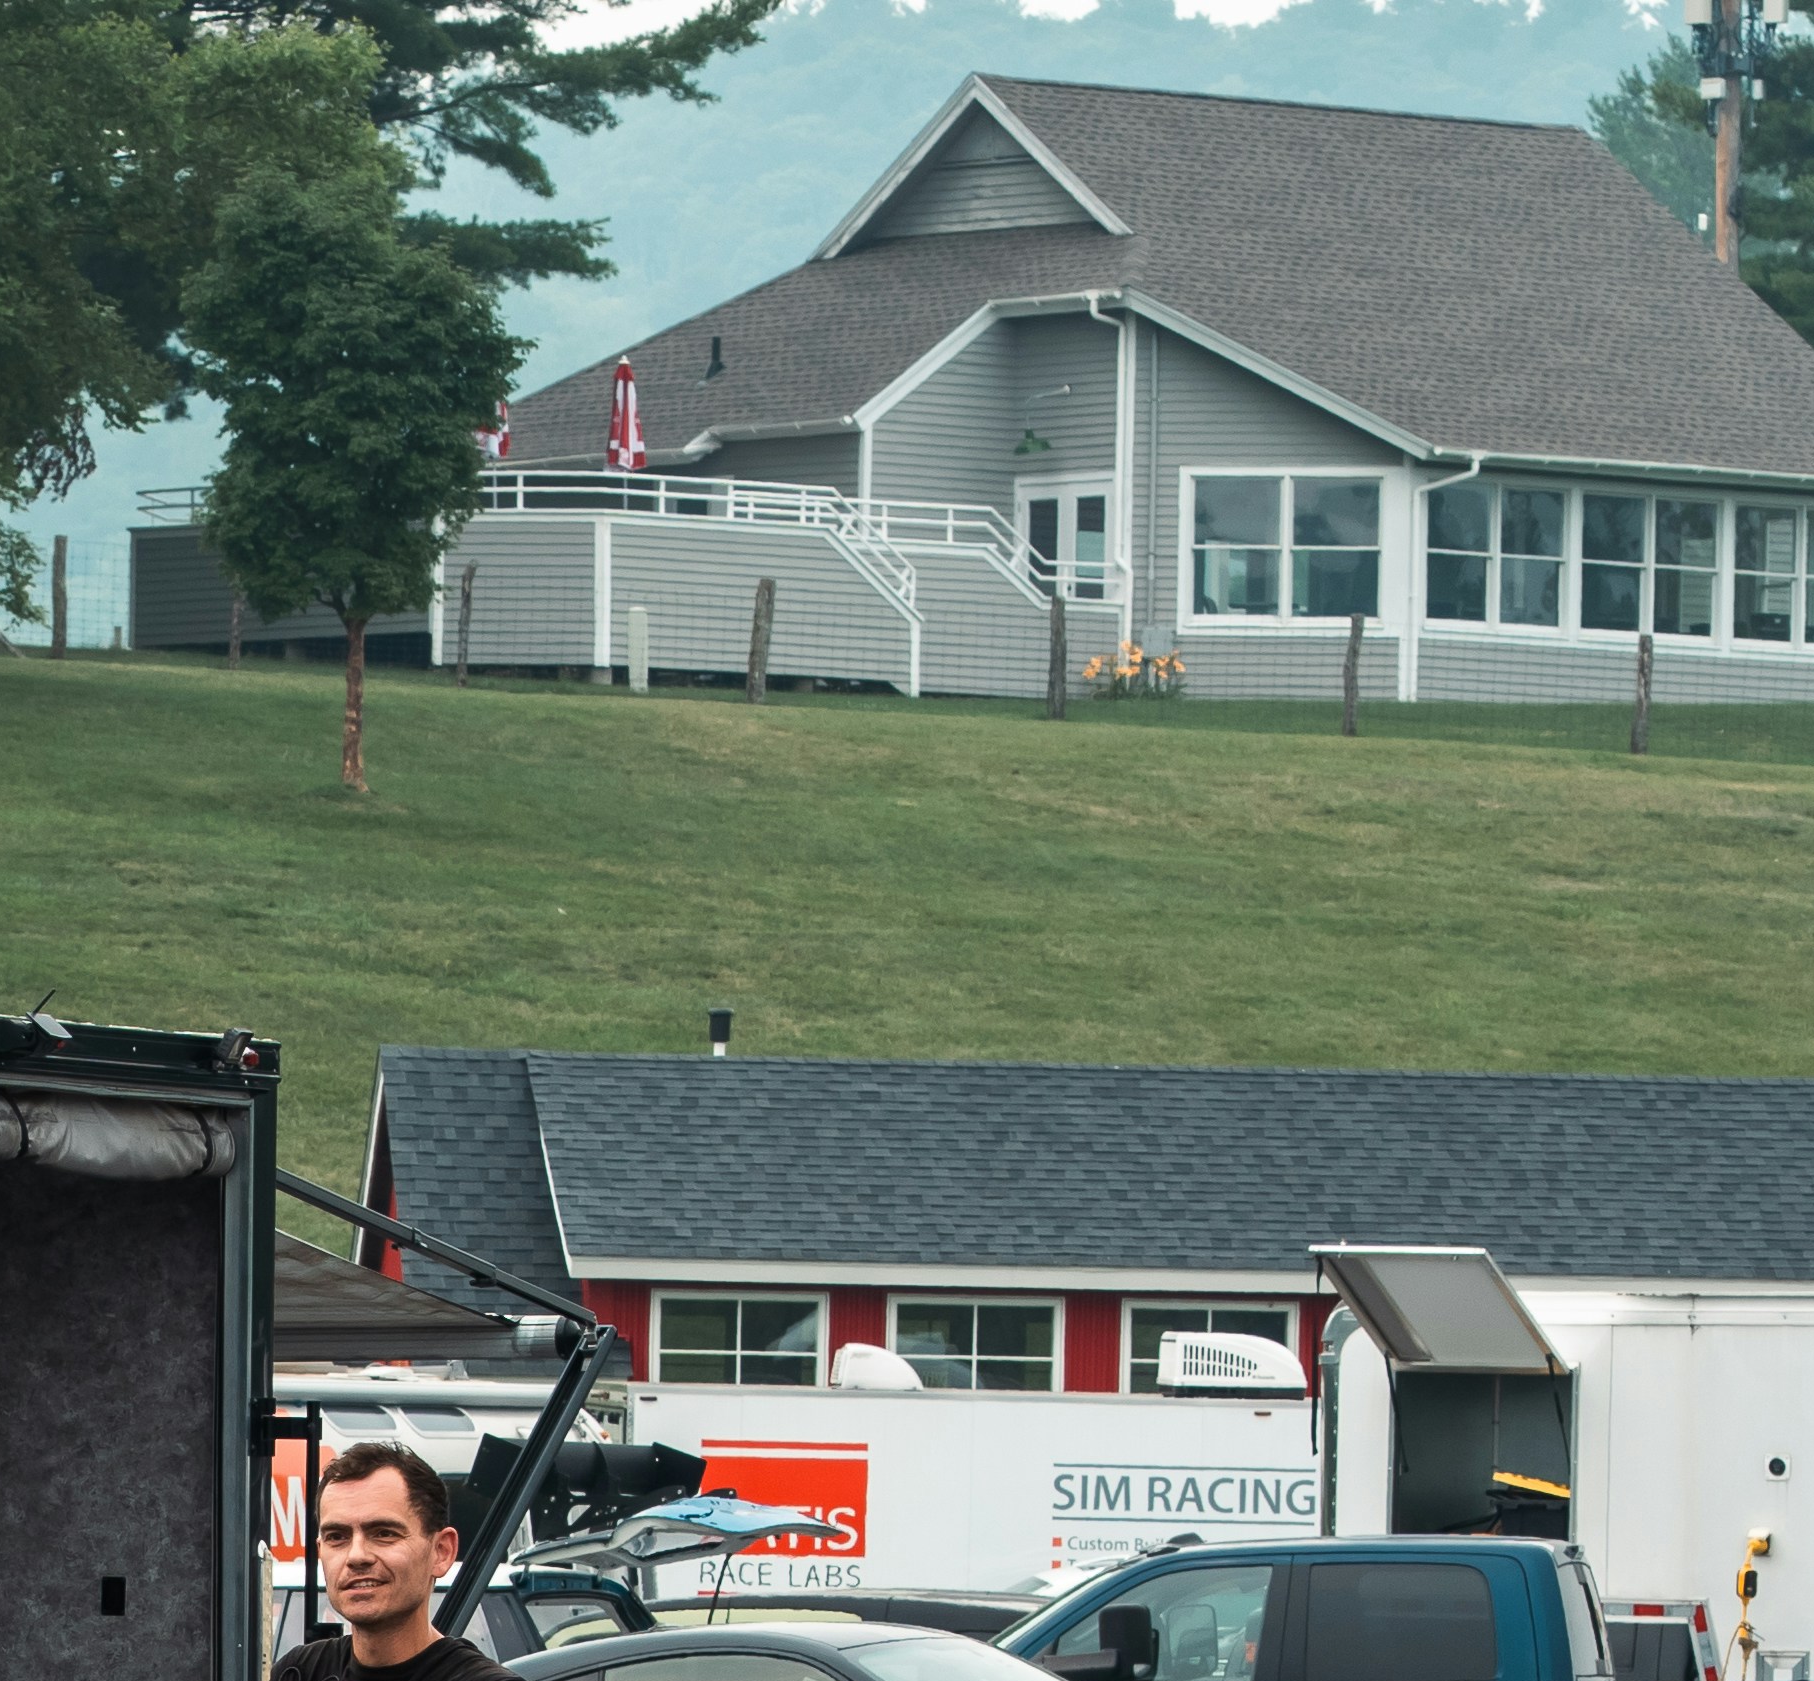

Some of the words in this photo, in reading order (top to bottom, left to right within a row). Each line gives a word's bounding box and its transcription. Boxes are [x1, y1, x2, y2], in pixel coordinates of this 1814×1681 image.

[1052, 1473, 1131, 1511] SIM
[1147, 1475, 1317, 1516] RACING
[1067, 1535, 1129, 1551] Custom
[699, 1561, 773, 1586] RACE
[789, 1563, 861, 1588] LABS
